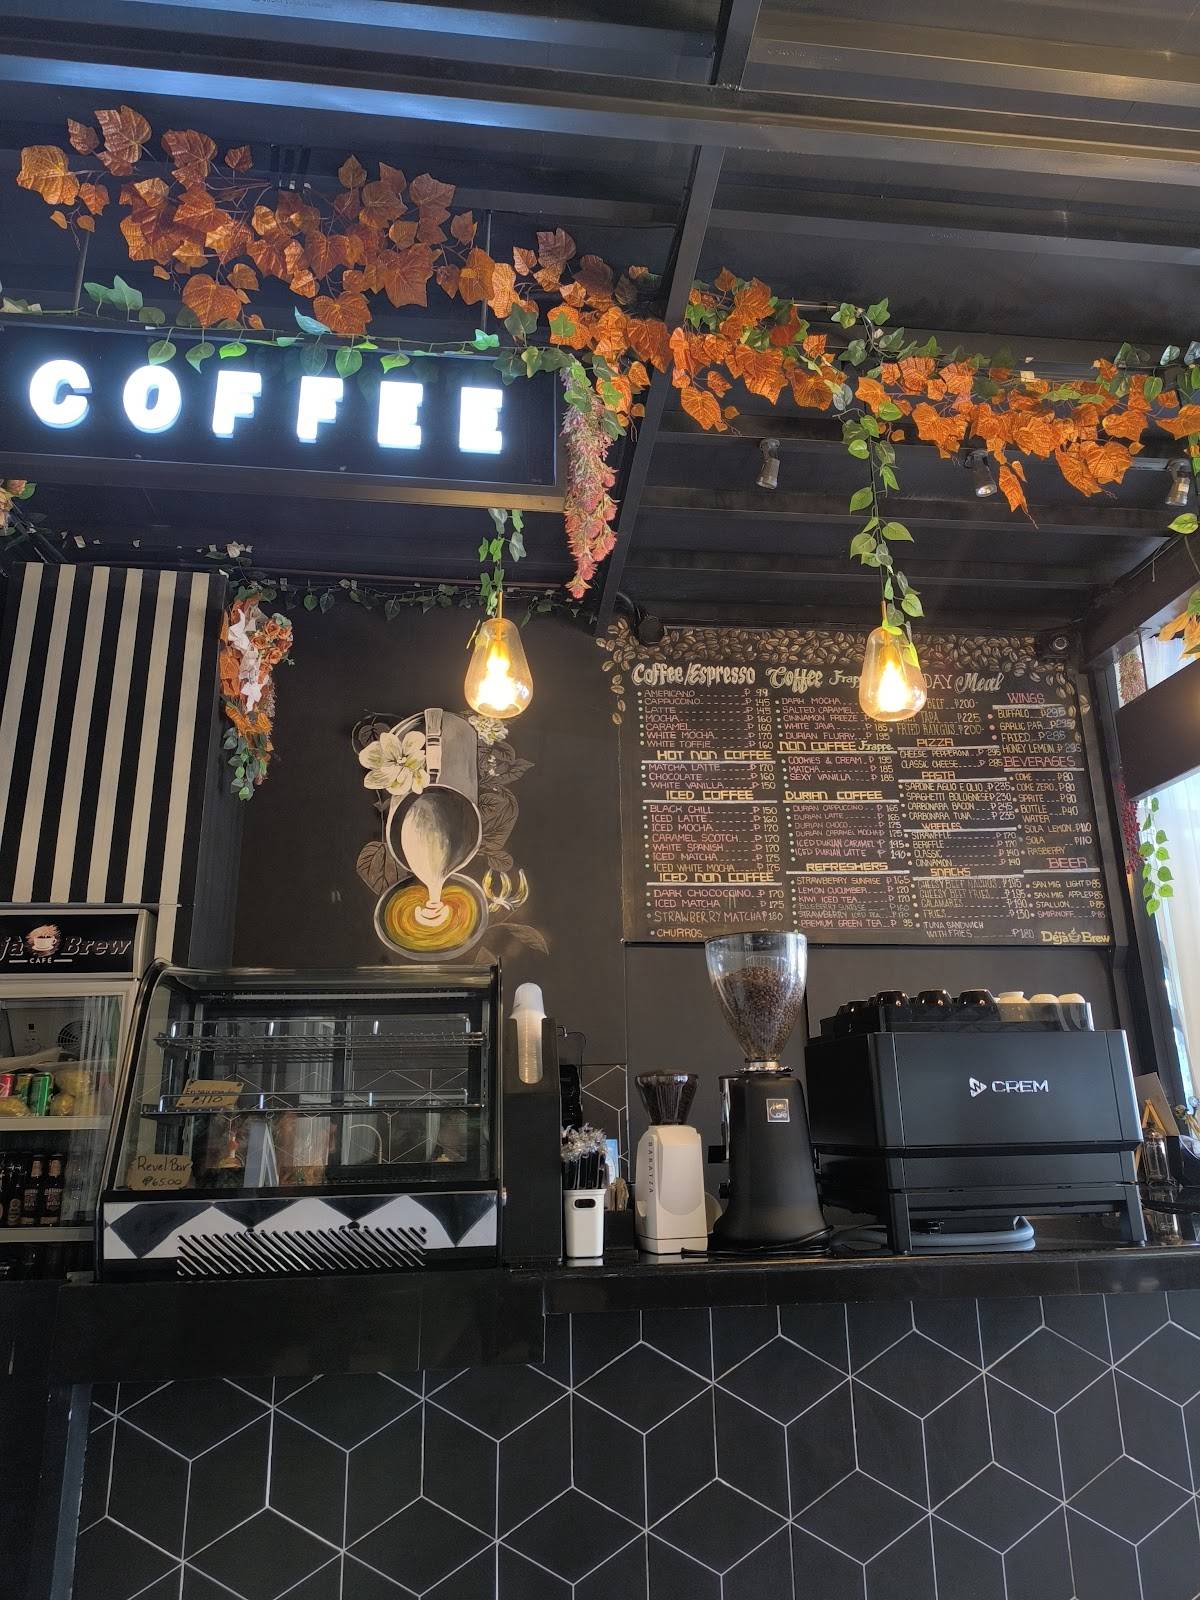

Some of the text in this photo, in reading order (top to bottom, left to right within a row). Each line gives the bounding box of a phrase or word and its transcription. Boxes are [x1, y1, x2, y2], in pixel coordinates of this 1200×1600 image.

[29, 359, 504, 454] COFFEE
[765, 666, 823, 694] Coffee
[955, 672, 1005, 693] Meal
[644, 690, 695, 698] AMERICANO
[1007, 692, 1045, 704] WINGS
[782, 697, 840, 705] DARK MOCHA
[644, 706, 677, 714] LATTE
[783, 706, 853, 714] SALTED CARAMEL
[997, 709, 1030, 718] BUFFALO
[645, 714, 680, 722] MOCHA
[830, 714, 858, 722] FREEZE
[645, 722, 691, 731] CARAMEL
[784, 722, 835, 730] WHITE JAVA
[646, 731, 715, 739] WHITE MOCHA
[785, 732, 856, 740] DURIAN FLURRY
[1001, 732, 1030, 742] FRIED
[811, 741, 857, 751] COFFEE
[916, 738, 954, 747] PIZZA
[1002, 744, 1055, 754] HONEY LEMON
[657, 750, 685, 760] HOT
[724, 750, 773, 760] COFFEE
[788, 756, 821, 764] COOKIES
[835, 756, 862, 764] CREAM
[931, 760, 959, 768] CHEESE
[1003, 756, 1076, 768] BEVERAGES
[648, 763, 721, 771] MATCHA LATTE
[788, 765, 820, 773] MATCHA
[921, 771, 956, 779] PASTA
[1014, 772, 1033, 781] COKE
[650, 782, 723, 790] WHITE VANILLA
[1036, 783, 1054, 791] ZERO
[666, 790, 754, 800] ICED COFFEE
[785, 791, 883, 800] DURIAN COFFEE
[906, 792, 945, 801] SPAGHETTI
[1018, 793, 1044, 802] SPRITE
[650, 805, 713, 814] BLACK CHILL
[907, 802, 975, 810] CARBONARA BACON
[1020, 804, 1048, 814] BOTTLE
[651, 814, 708, 823] ICED LATTE
[909, 811, 972, 820] CARBONARA TUNA
[1022, 814, 1050, 823] WATER
[652, 824, 713, 832] ICED MOCHA
[825, 821, 848, 829] CHOCO
[1048, 824, 1072, 833] LEMON
[652, 834, 739, 843] CARAMEL SCOTCH
[653, 843, 724, 852] WHITE SPANISH
[796, 839, 816, 847] ICED
[844, 840, 876, 848] CARAMEL
[652, 853, 718, 861] ICED MATCHA
[795, 848, 813, 857] ICED
[843, 848, 867, 857] LATTE
[806, 862, 889, 871] REFRESHERS
[915, 859, 953, 867] CINNAMON
[1046, 857, 1088, 869] BEER
[653, 864, 735, 873] ICED WHITE MOCHA
[930, 867, 971, 877] SNACKS
[660, 873, 688, 882] ICED
[728, 872, 774, 882] COFFEE
[796, 877, 847, 885] STRAWBERRY
[653, 889, 682, 898] DARK
[655, 899, 720, 907] ICED MATCHA
[840, 895, 858, 903] TEA
[654, 911, 763, 923] STRAWBERRY MATCHA
[801, 919, 834, 927] PREMIUM
[867, 919, 883, 927] TEA
[924, 921, 945, 929] TUNA
[656, 928, 704, 938] CHURROS
[949, 930, 973, 938] FRIES
[1081, 931, 1110, 943] Brew
[61, 936, 132, 956] Brew
[991, 1079, 1049, 1093] CREM
[136, 1155, 190, 1172] Revel Bar
